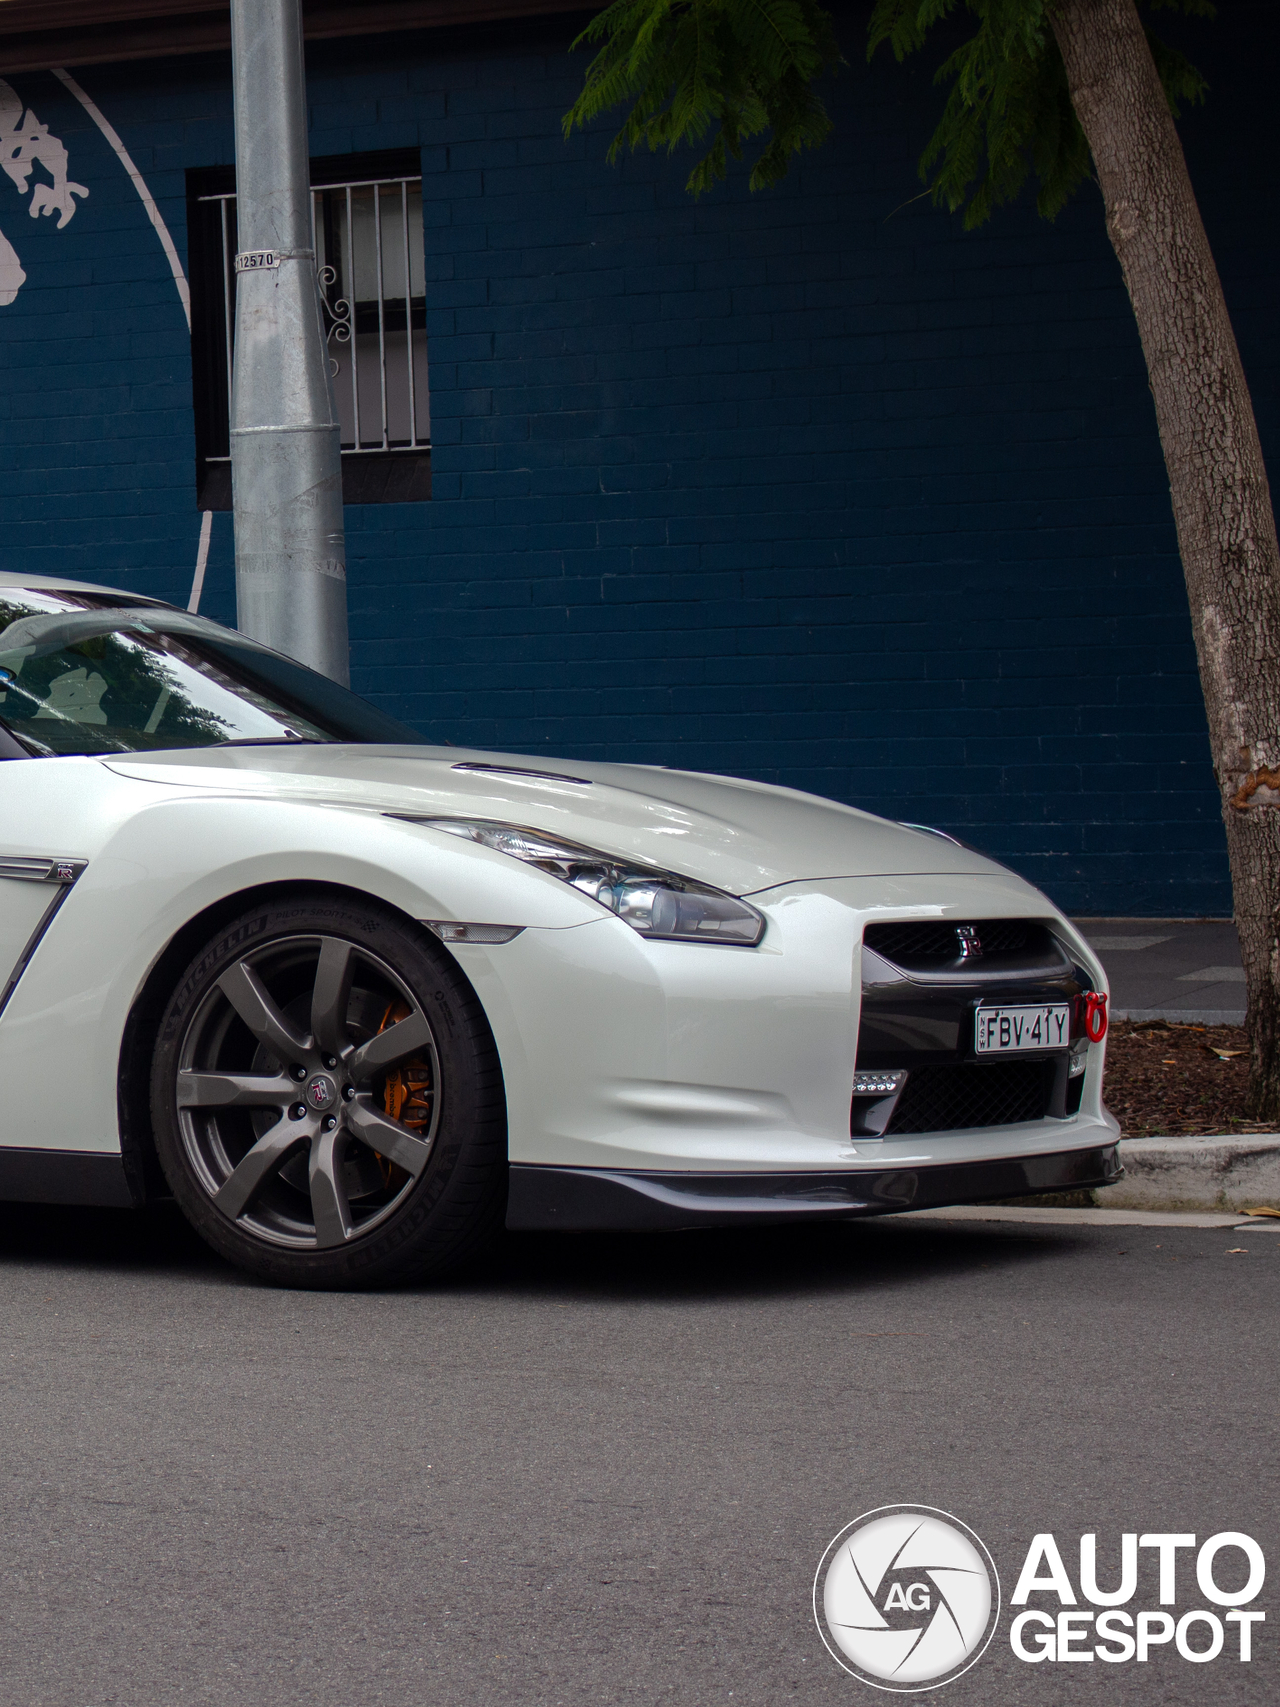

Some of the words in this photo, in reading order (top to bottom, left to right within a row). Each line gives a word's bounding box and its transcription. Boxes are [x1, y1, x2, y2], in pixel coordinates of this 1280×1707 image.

[276, 909, 306, 919] PILOT
[310, 908, 346, 919] SPORT
[176, 917, 264, 1012] MICHELIN
